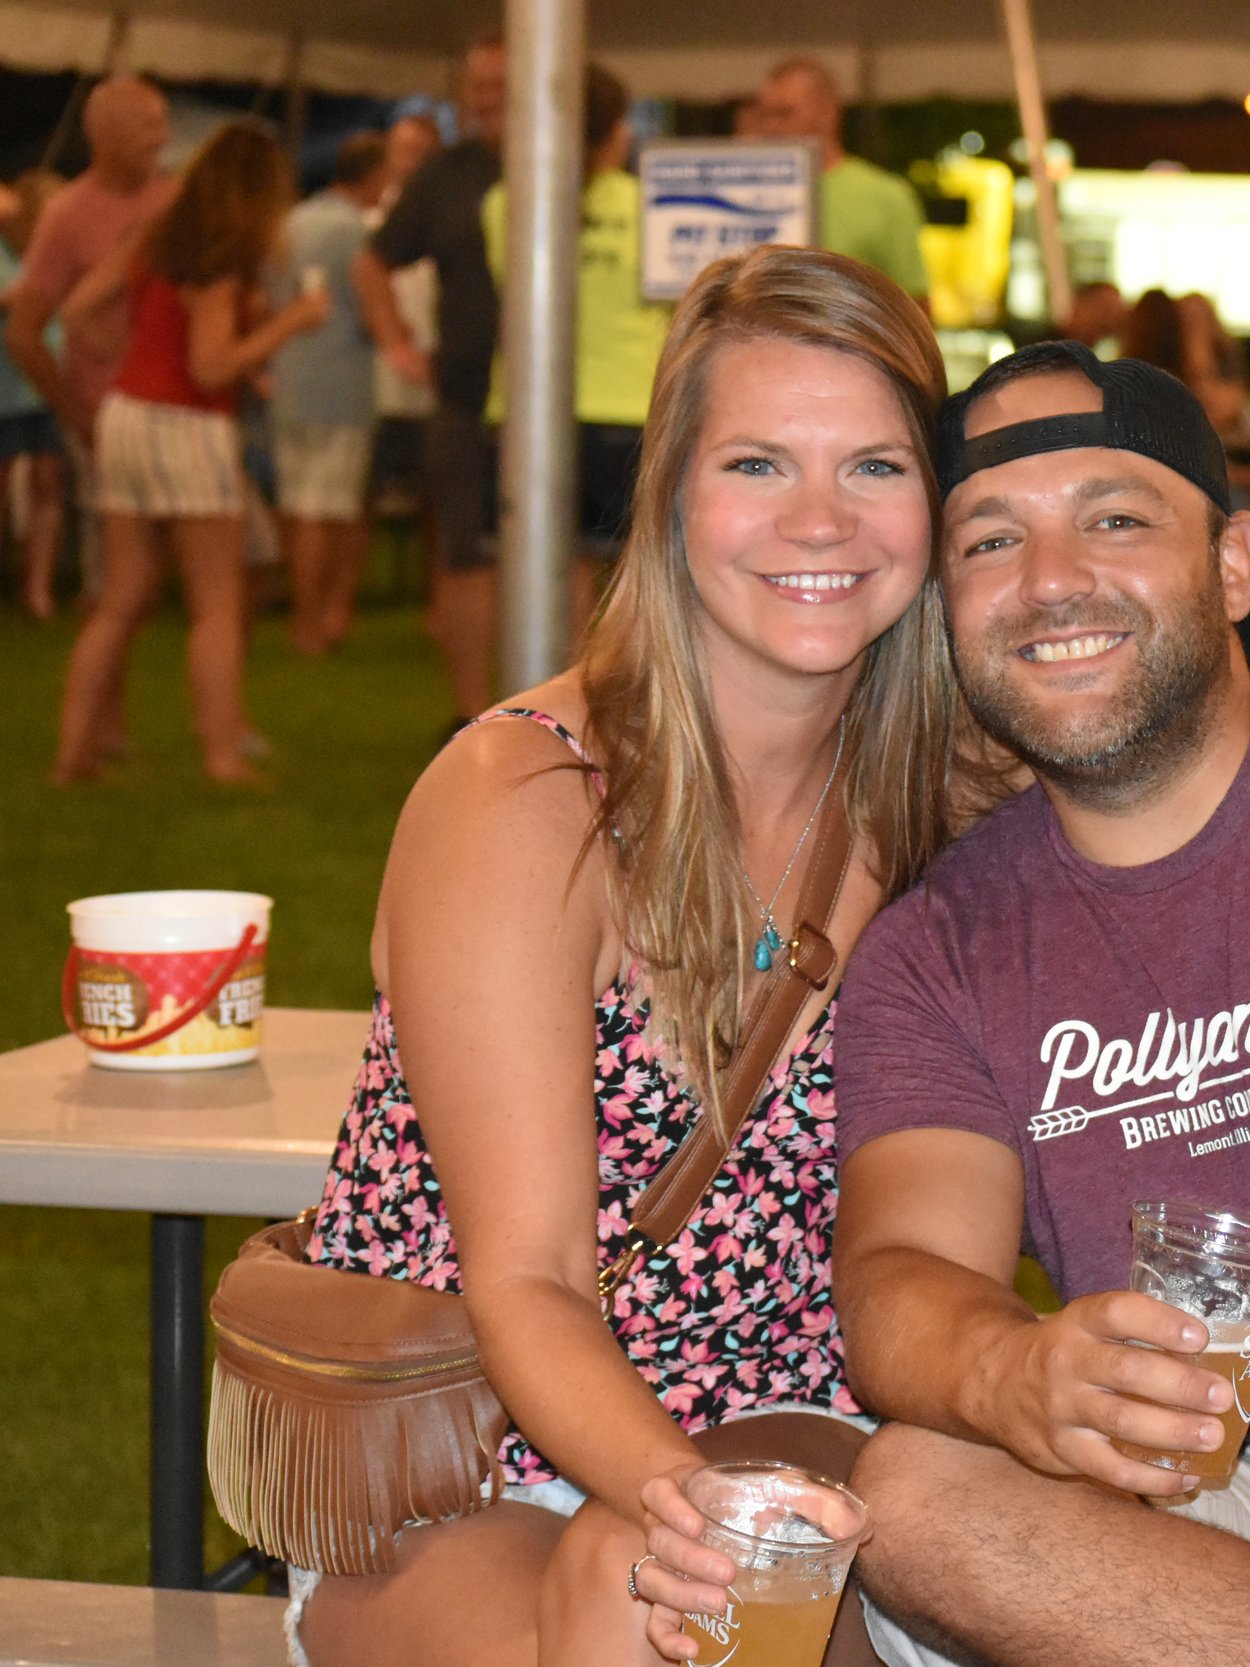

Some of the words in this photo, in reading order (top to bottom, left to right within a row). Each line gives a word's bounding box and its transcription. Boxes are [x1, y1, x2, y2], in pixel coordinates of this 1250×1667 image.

[79, 982, 132, 1002] ENCH
[81, 1001, 137, 1028] RIES
[1120, 1098, 1226, 1150] BREWING
